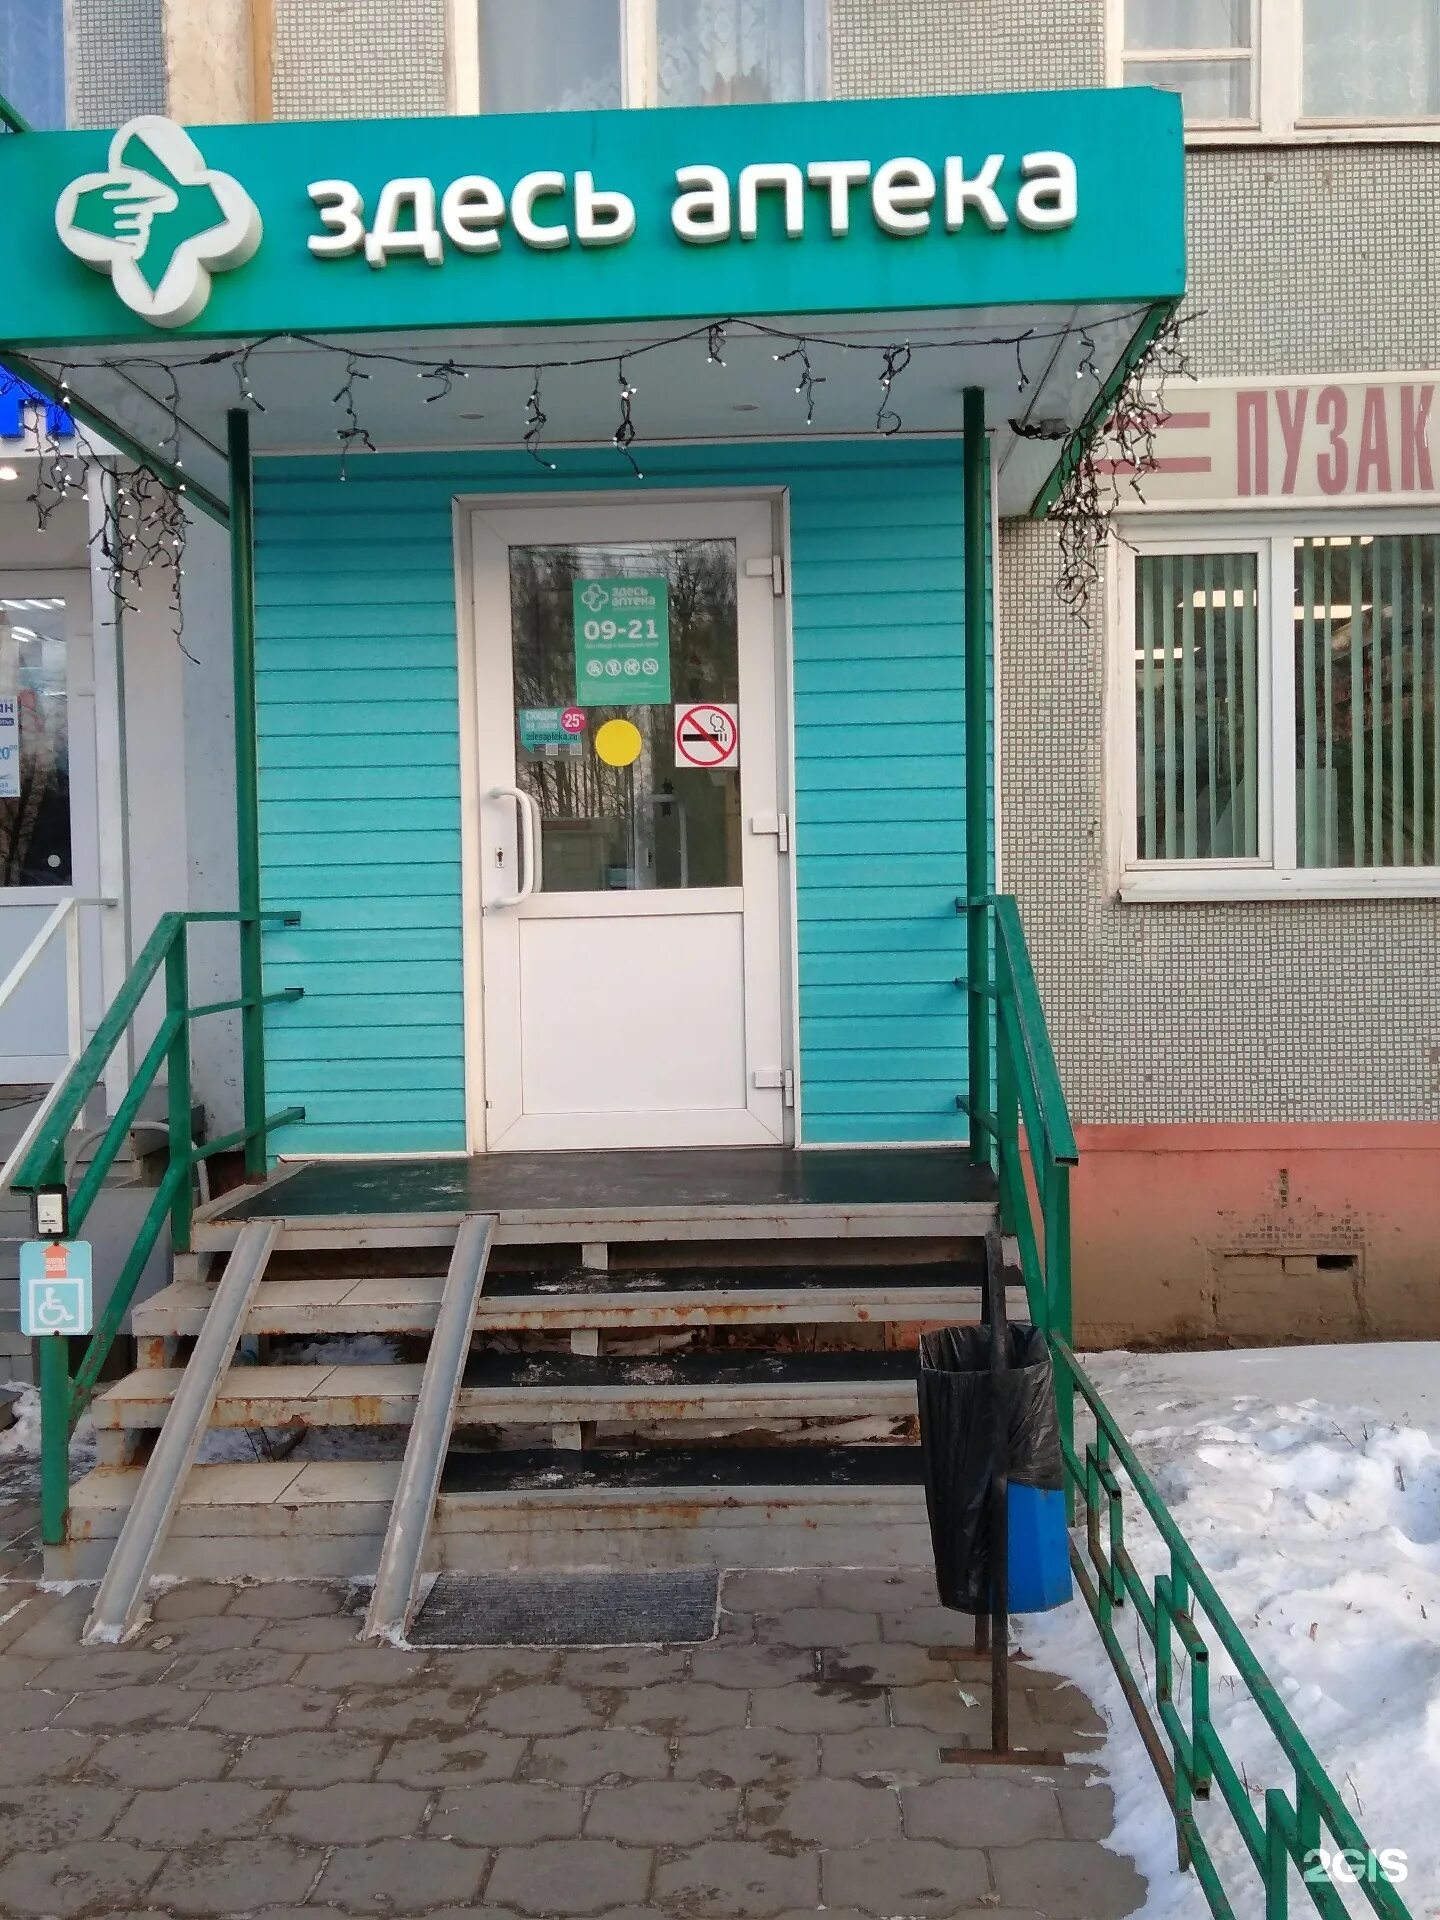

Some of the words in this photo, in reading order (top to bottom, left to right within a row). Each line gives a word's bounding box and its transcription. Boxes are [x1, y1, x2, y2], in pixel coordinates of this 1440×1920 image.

[307, 171, 636, 268] здесь
[671, 149, 1078, 243] аптека
[1237, 385, 1434, 496] ПУЗАК
[584, 620, 658, 640] 09-21
